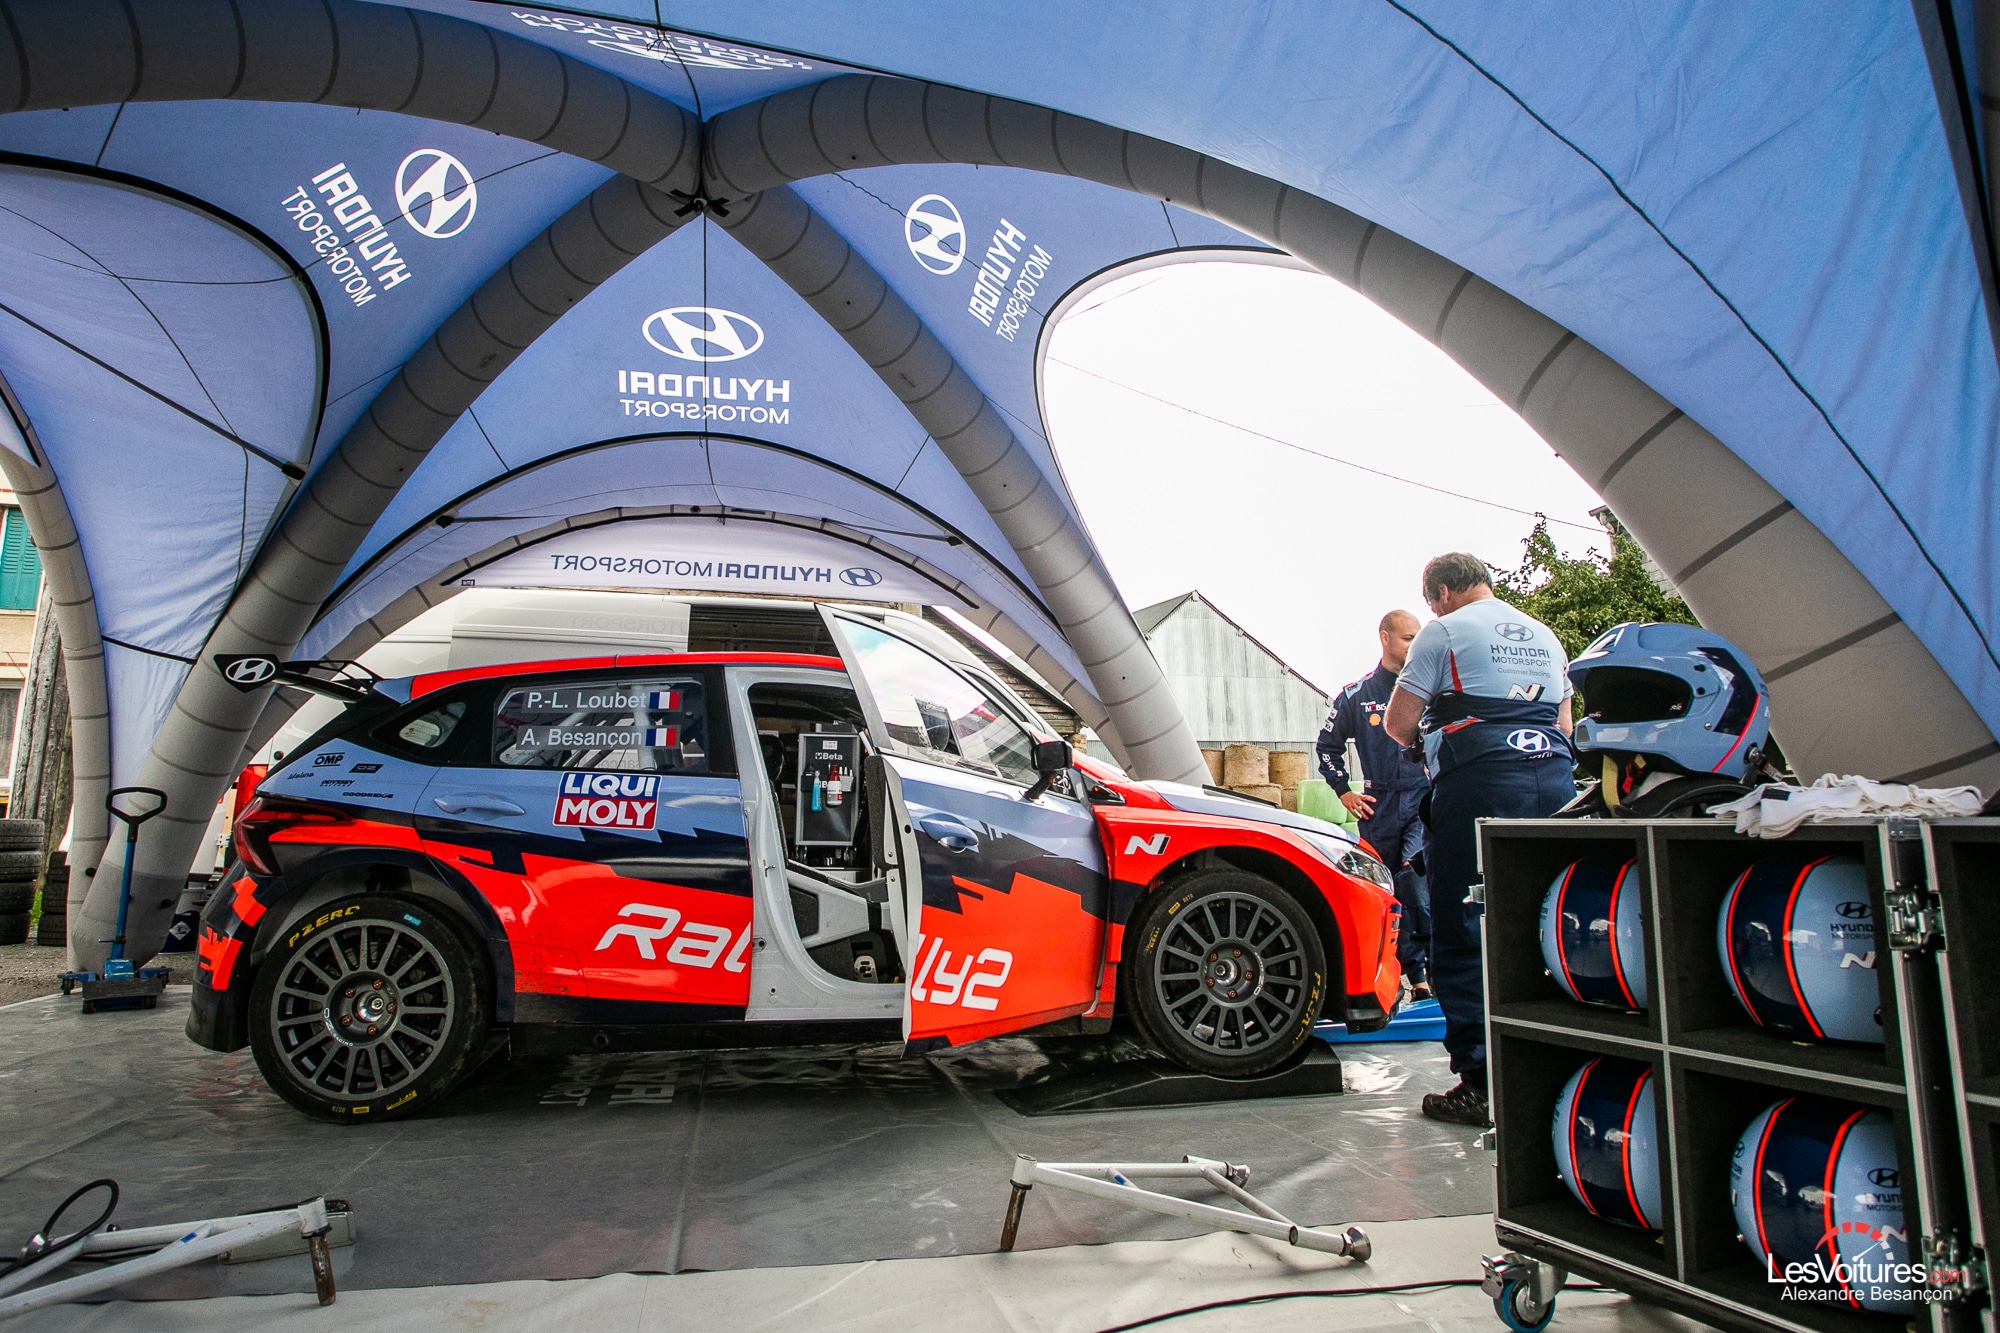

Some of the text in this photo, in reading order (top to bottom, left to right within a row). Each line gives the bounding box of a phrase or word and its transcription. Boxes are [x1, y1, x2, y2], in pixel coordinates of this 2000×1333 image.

[1490, 644, 1550, 659] HYUNDAI
[1492, 656, 1551, 667] MOTORSPORT
[1497, 668, 1551, 678] Customer Racing
[527, 691, 647, 709] P.-L. Loubet
[521, 728, 642, 748] A. Besançon
[314, 754, 344, 765] OMP
[822, 752, 843, 760] Beta
[564, 773, 657, 798] LIQUI
[559, 798, 656, 826] MOLY
[1830, 923, 1874, 932] HYUND
